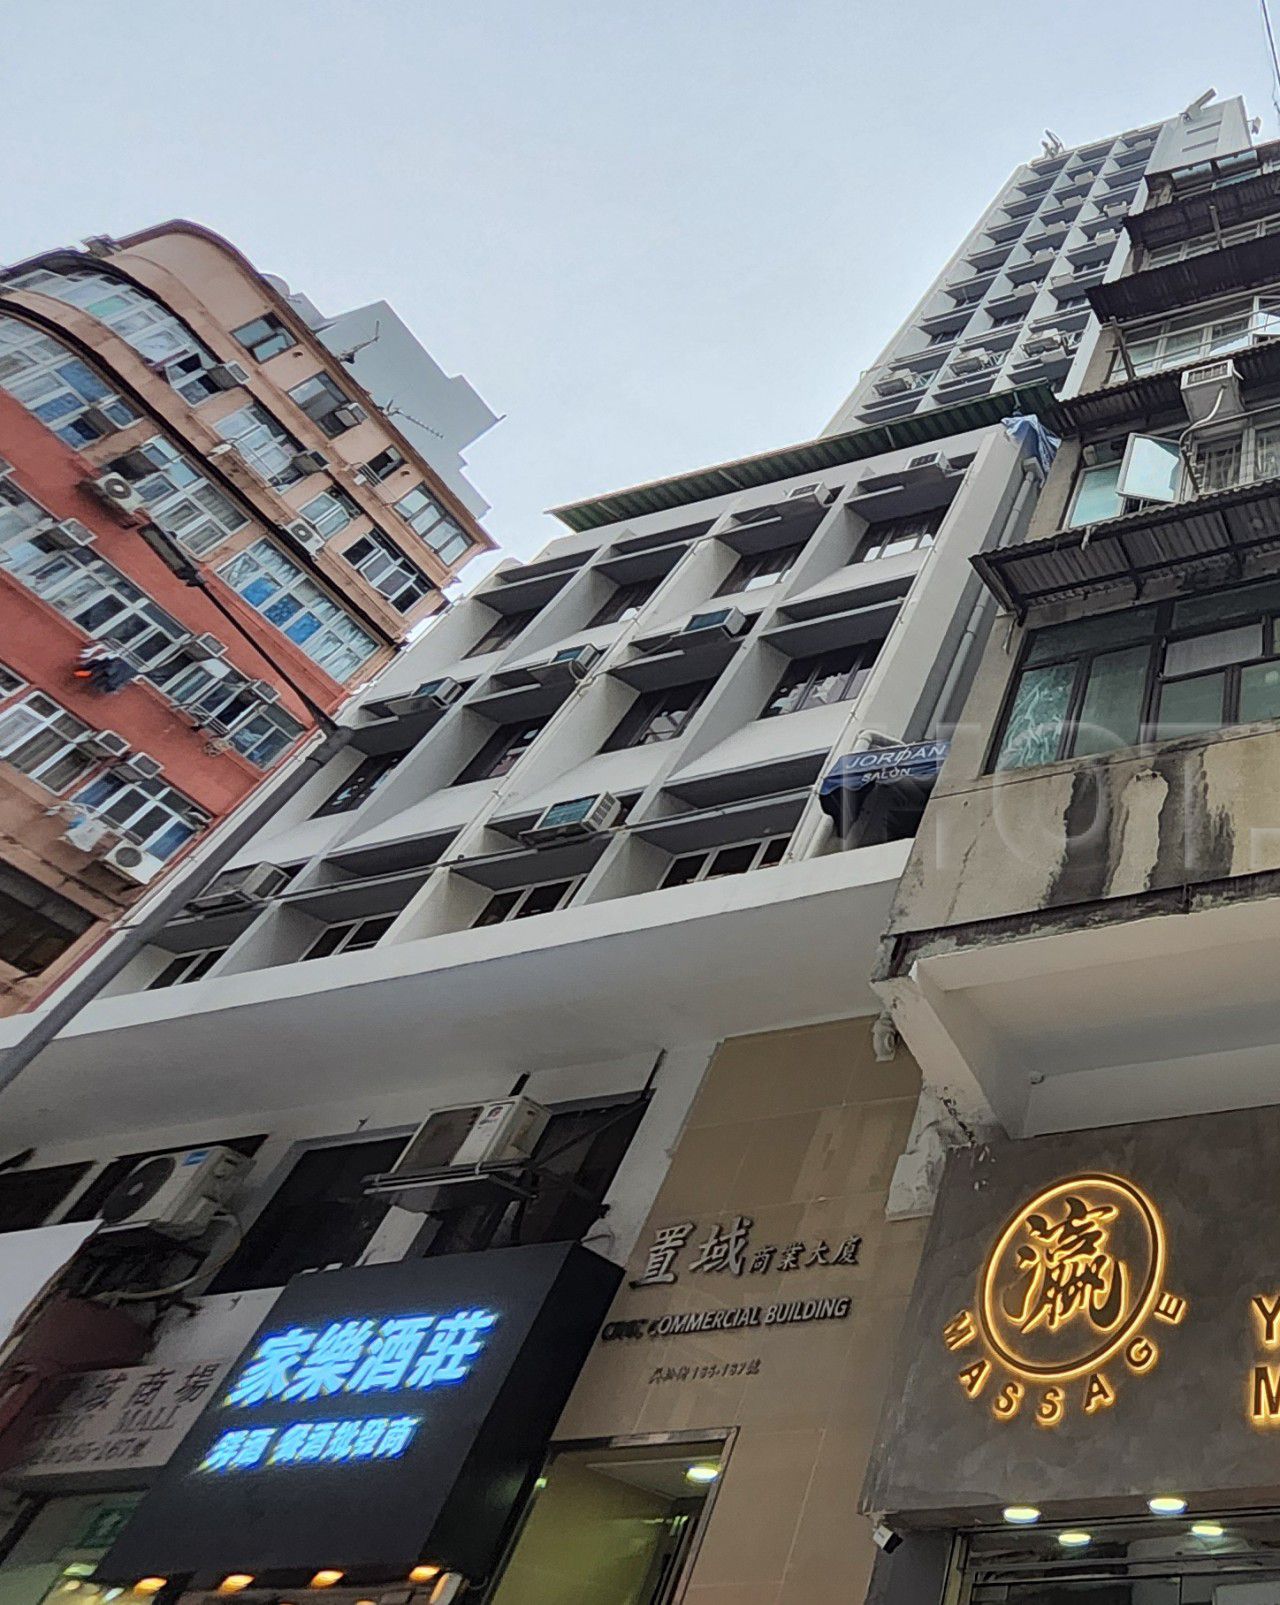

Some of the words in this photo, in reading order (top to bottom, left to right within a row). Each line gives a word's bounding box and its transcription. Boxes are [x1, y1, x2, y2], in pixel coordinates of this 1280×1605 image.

[847, 745, 945, 769] JORDAN
[861, 767, 911, 782] SALON
[628, 1215, 862, 1289] 置域商業大廈
[1003, 1197, 1125, 1333] 瀛
[651, 1302, 761, 1337] COMMERCIAL
[764, 1297, 851, 1326] BUILDING
[224, 1308, 499, 1408] 家樂酒莊
[944, 1292, 1186, 1424] MASSAGE
[109, 1405, 181, 1435] MALL
